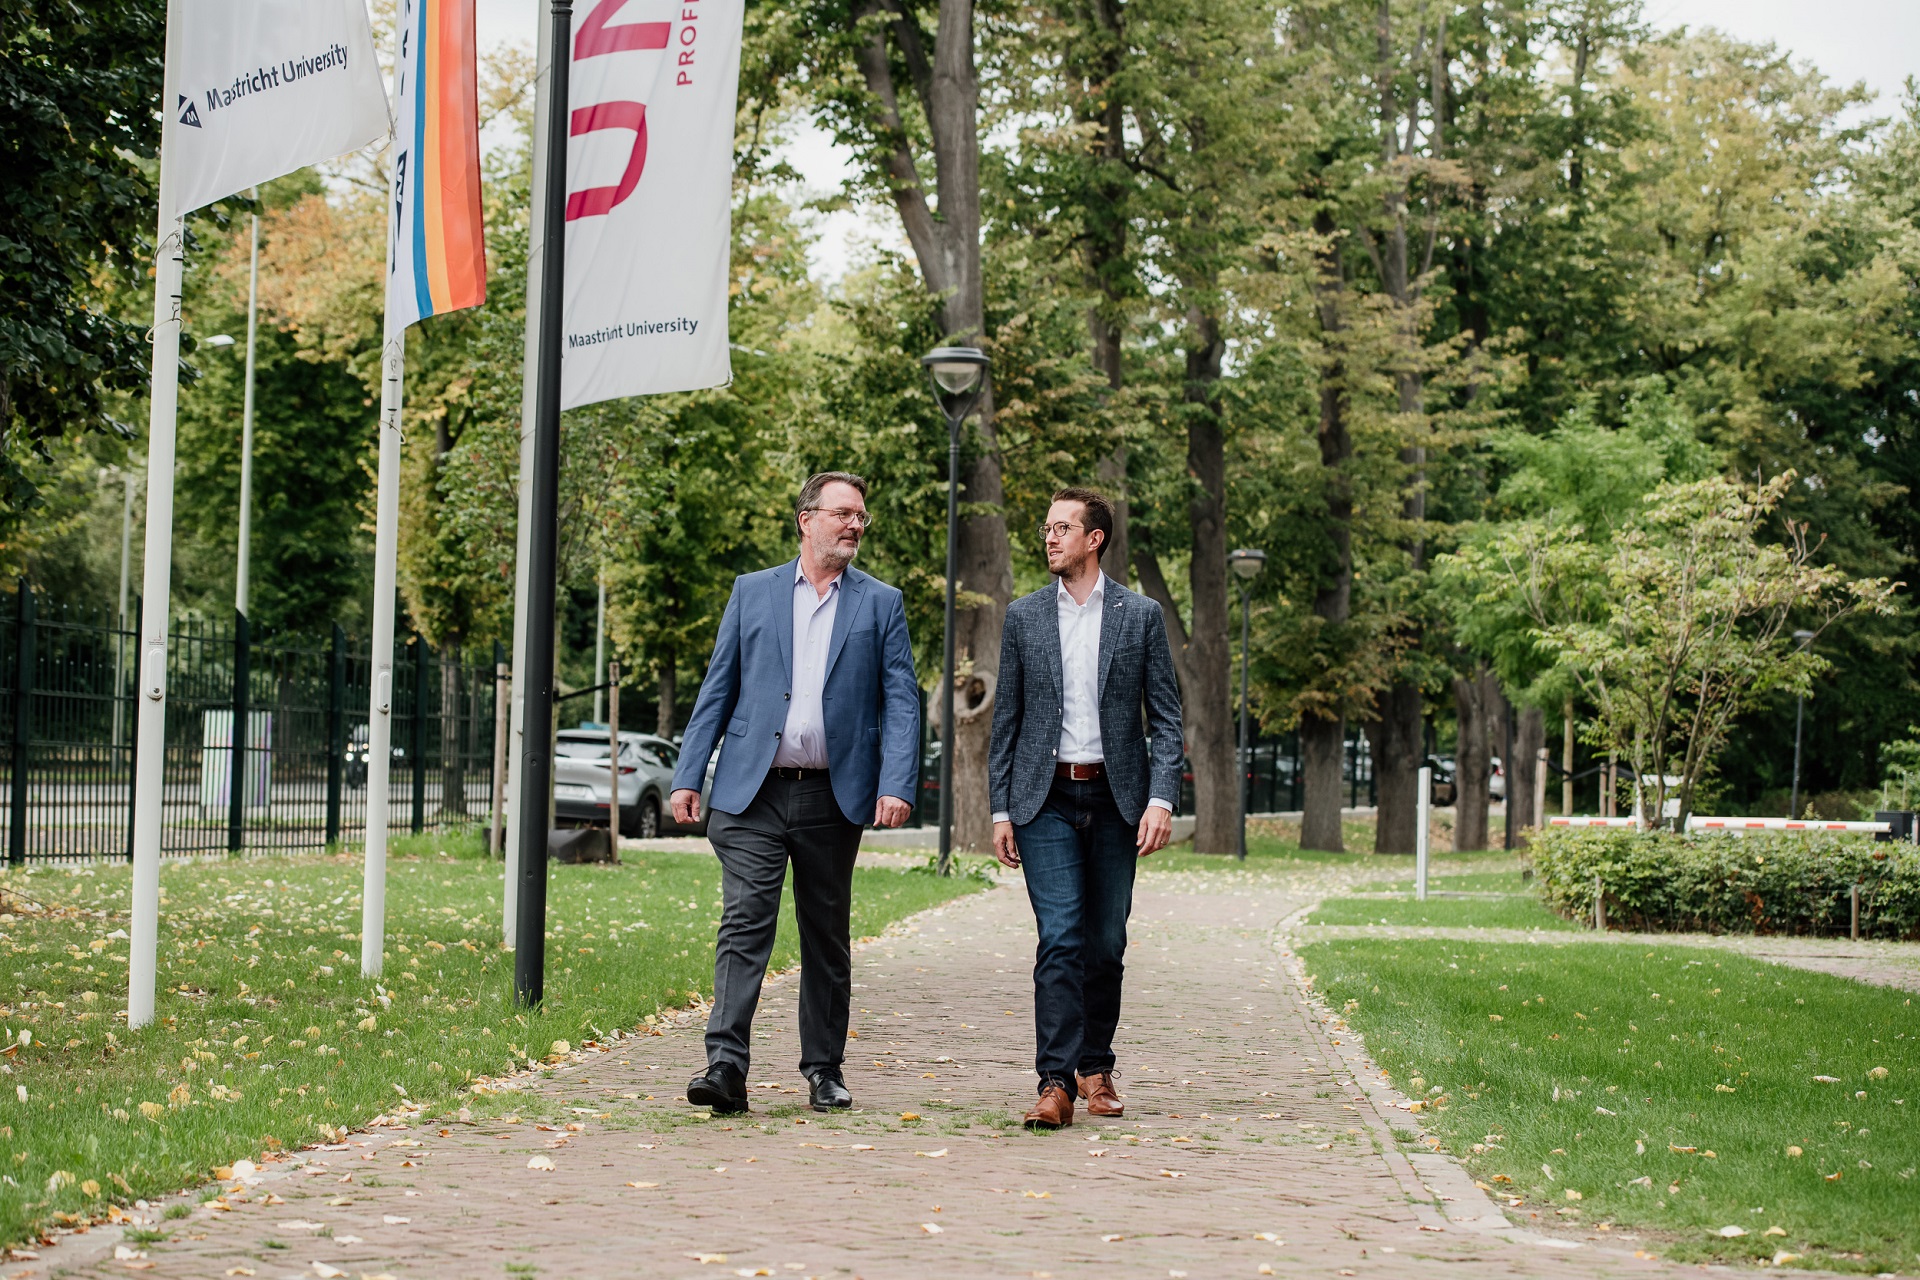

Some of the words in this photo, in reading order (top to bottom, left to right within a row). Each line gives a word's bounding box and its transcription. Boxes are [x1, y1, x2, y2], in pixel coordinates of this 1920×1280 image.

[281, 43, 348, 83] University
[676, 0, 700, 86] PROF
[626, 317, 699, 336] University
